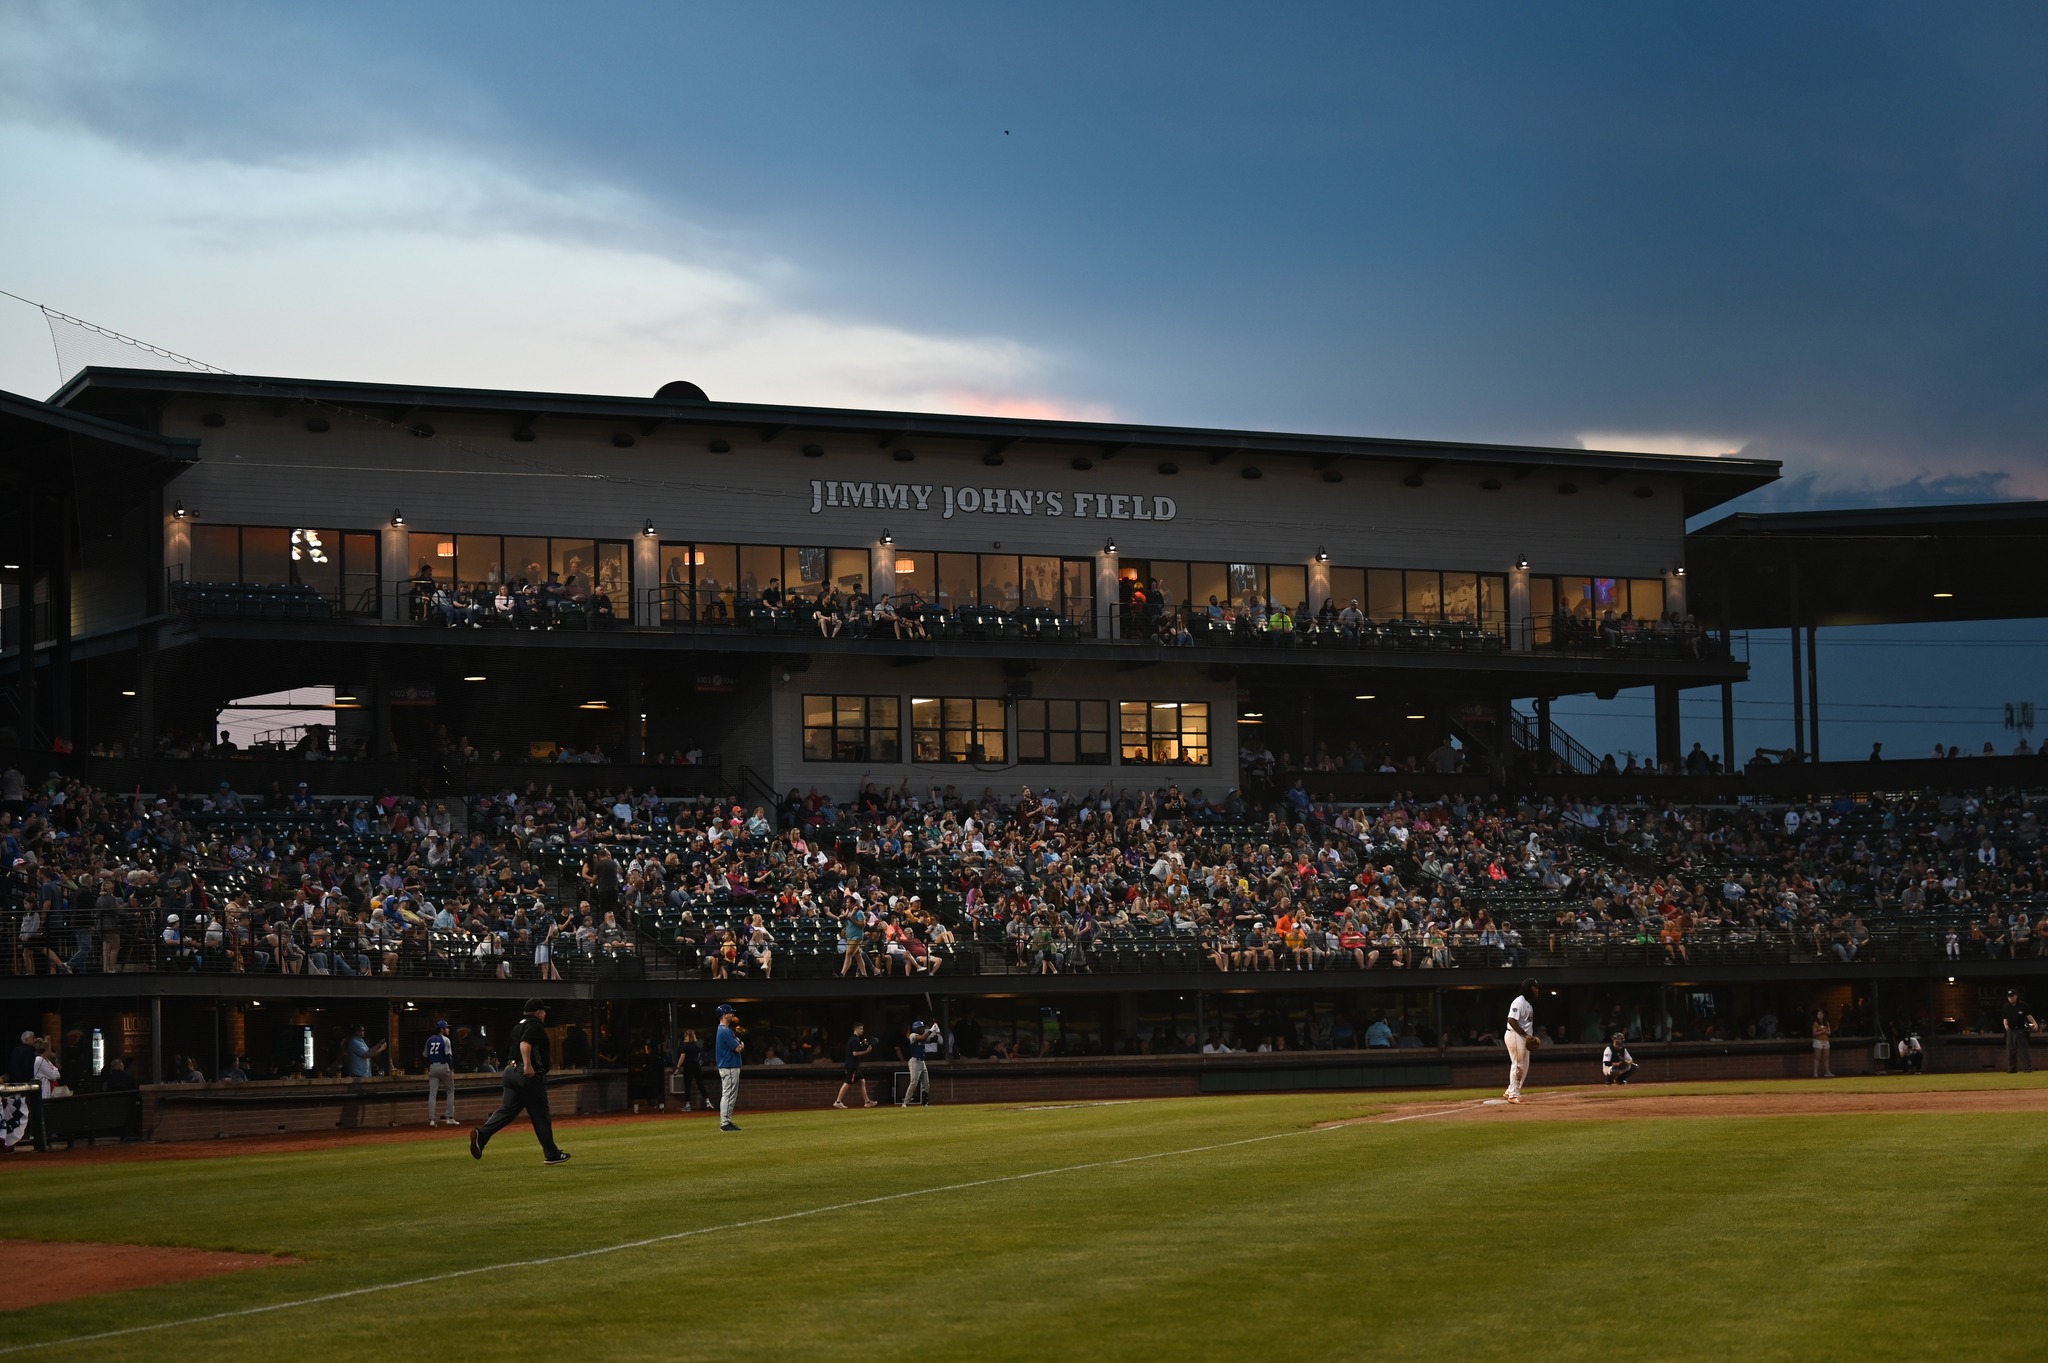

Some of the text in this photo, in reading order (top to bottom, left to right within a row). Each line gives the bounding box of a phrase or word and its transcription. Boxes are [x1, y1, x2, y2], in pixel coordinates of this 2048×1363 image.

[810, 480, 1178, 521] JIMMY JOHN'S FIELD
[430, 1042, 441, 1055] 22
